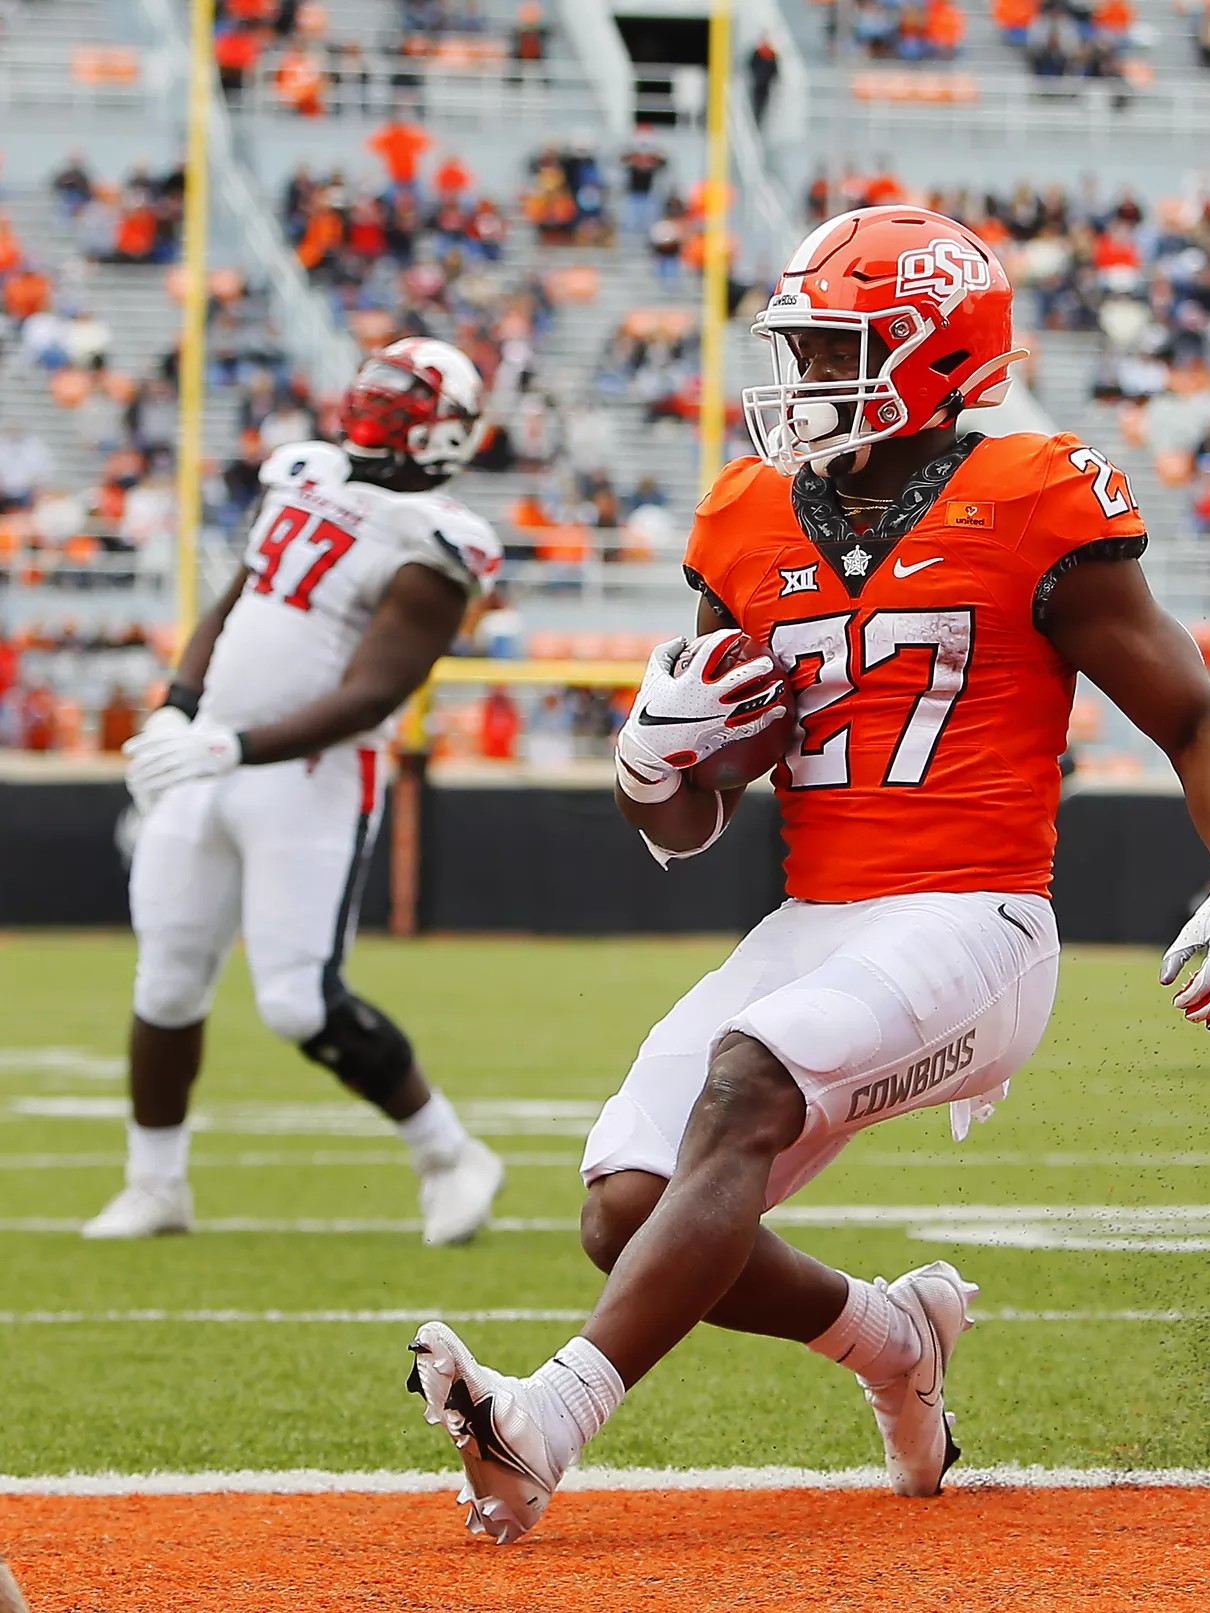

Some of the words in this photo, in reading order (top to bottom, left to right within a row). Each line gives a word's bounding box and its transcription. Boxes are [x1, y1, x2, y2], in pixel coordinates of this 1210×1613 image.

[896, 238, 990, 302] OSU
[1068, 447, 1139, 520] 2
[955, 516, 986, 526] united
[254, 504, 357, 613] 97
[779, 563, 819, 598] XII
[767, 606, 976, 793] 27
[844, 1027, 977, 1124] COWBOYS
